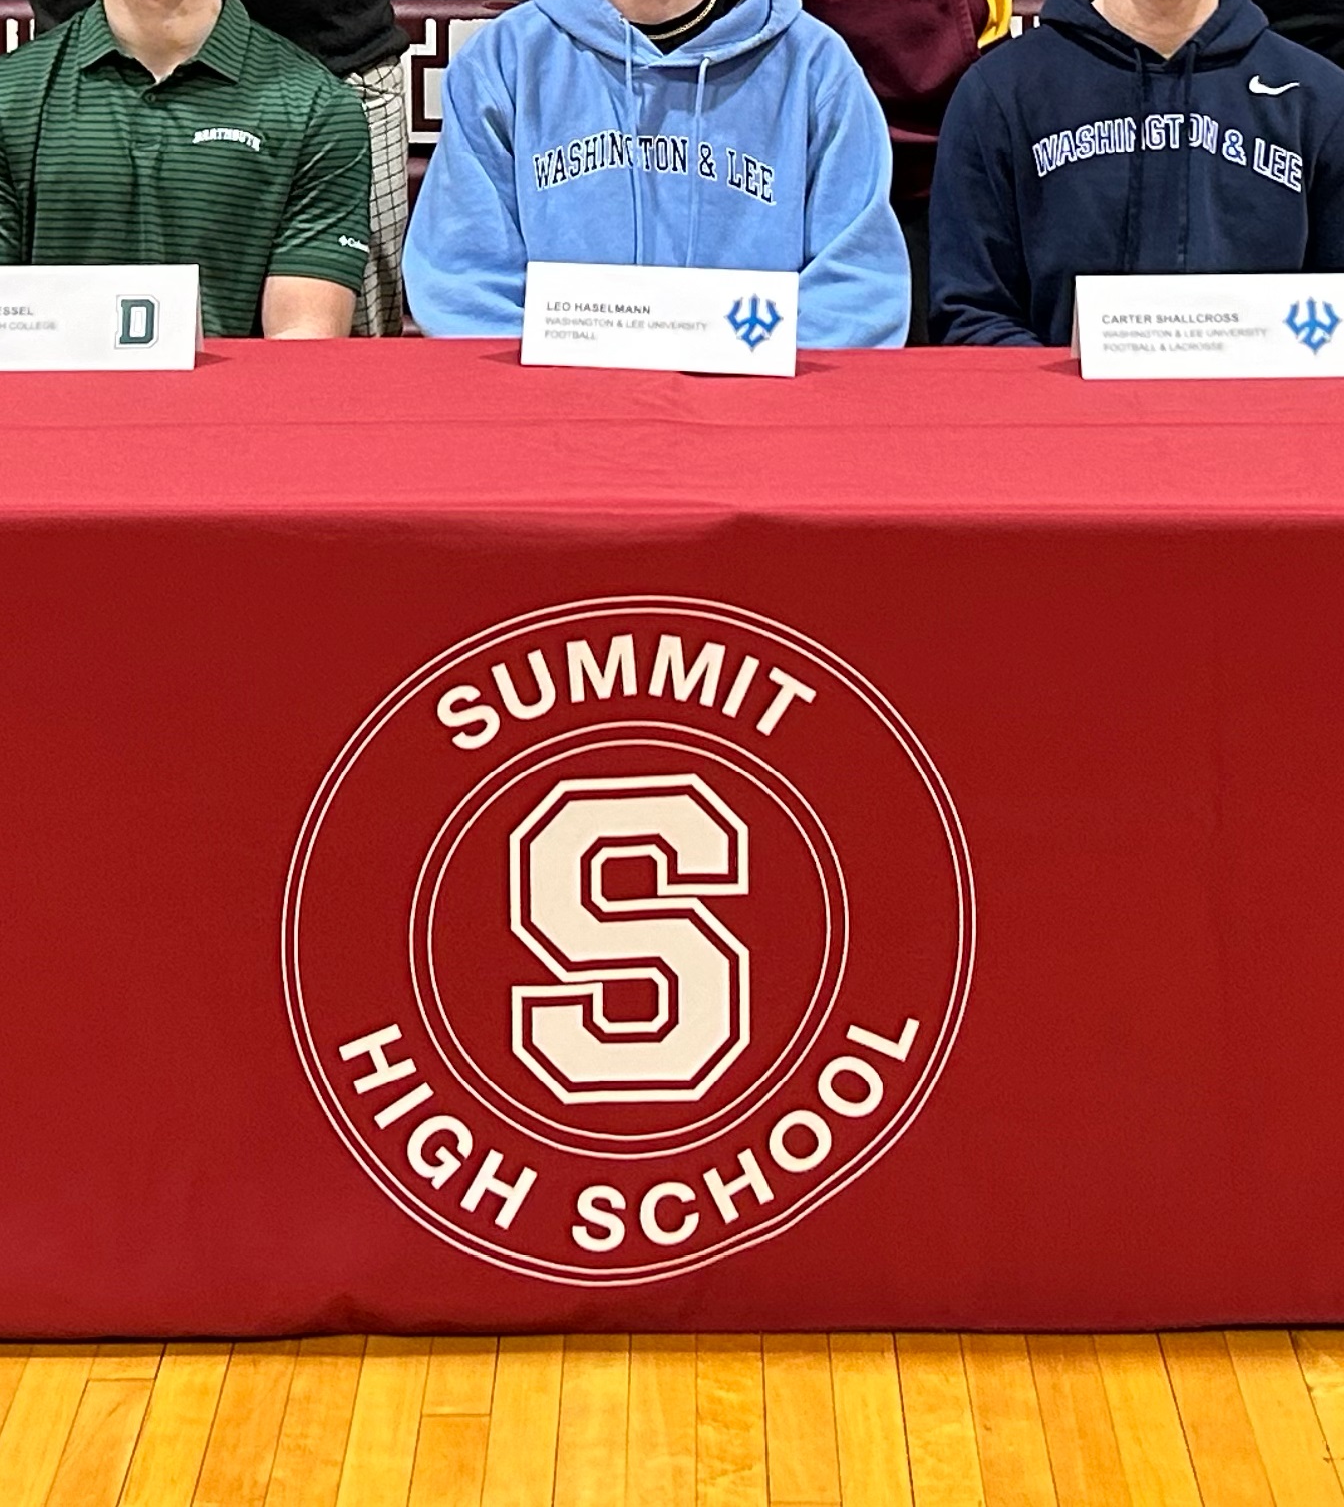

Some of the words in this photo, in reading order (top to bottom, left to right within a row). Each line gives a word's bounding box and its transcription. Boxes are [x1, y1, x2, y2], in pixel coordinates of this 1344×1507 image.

[698, 142, 716, 180] &
[726, 147, 777, 205] LEE
[1222, 129, 1247, 165] &
[1253, 138, 1303, 193] LEE
[115, 295, 158, 348] D
[544, 331, 597, 340] FOOTBALL
[546, 302, 571, 312] LEO
[574, 303, 651, 315] HASELMANN
[616, 320, 624, 328] &
[1101, 314, 1152, 324] CARTER
[1156, 313, 1239, 324] SHALLCROSS
[435, 632, 817, 751] SUMMIT
[510, 773, 750, 1104] S
[339, 1023, 538, 1230] HIGH
[571, 1017, 920, 1253] SCHOOL
